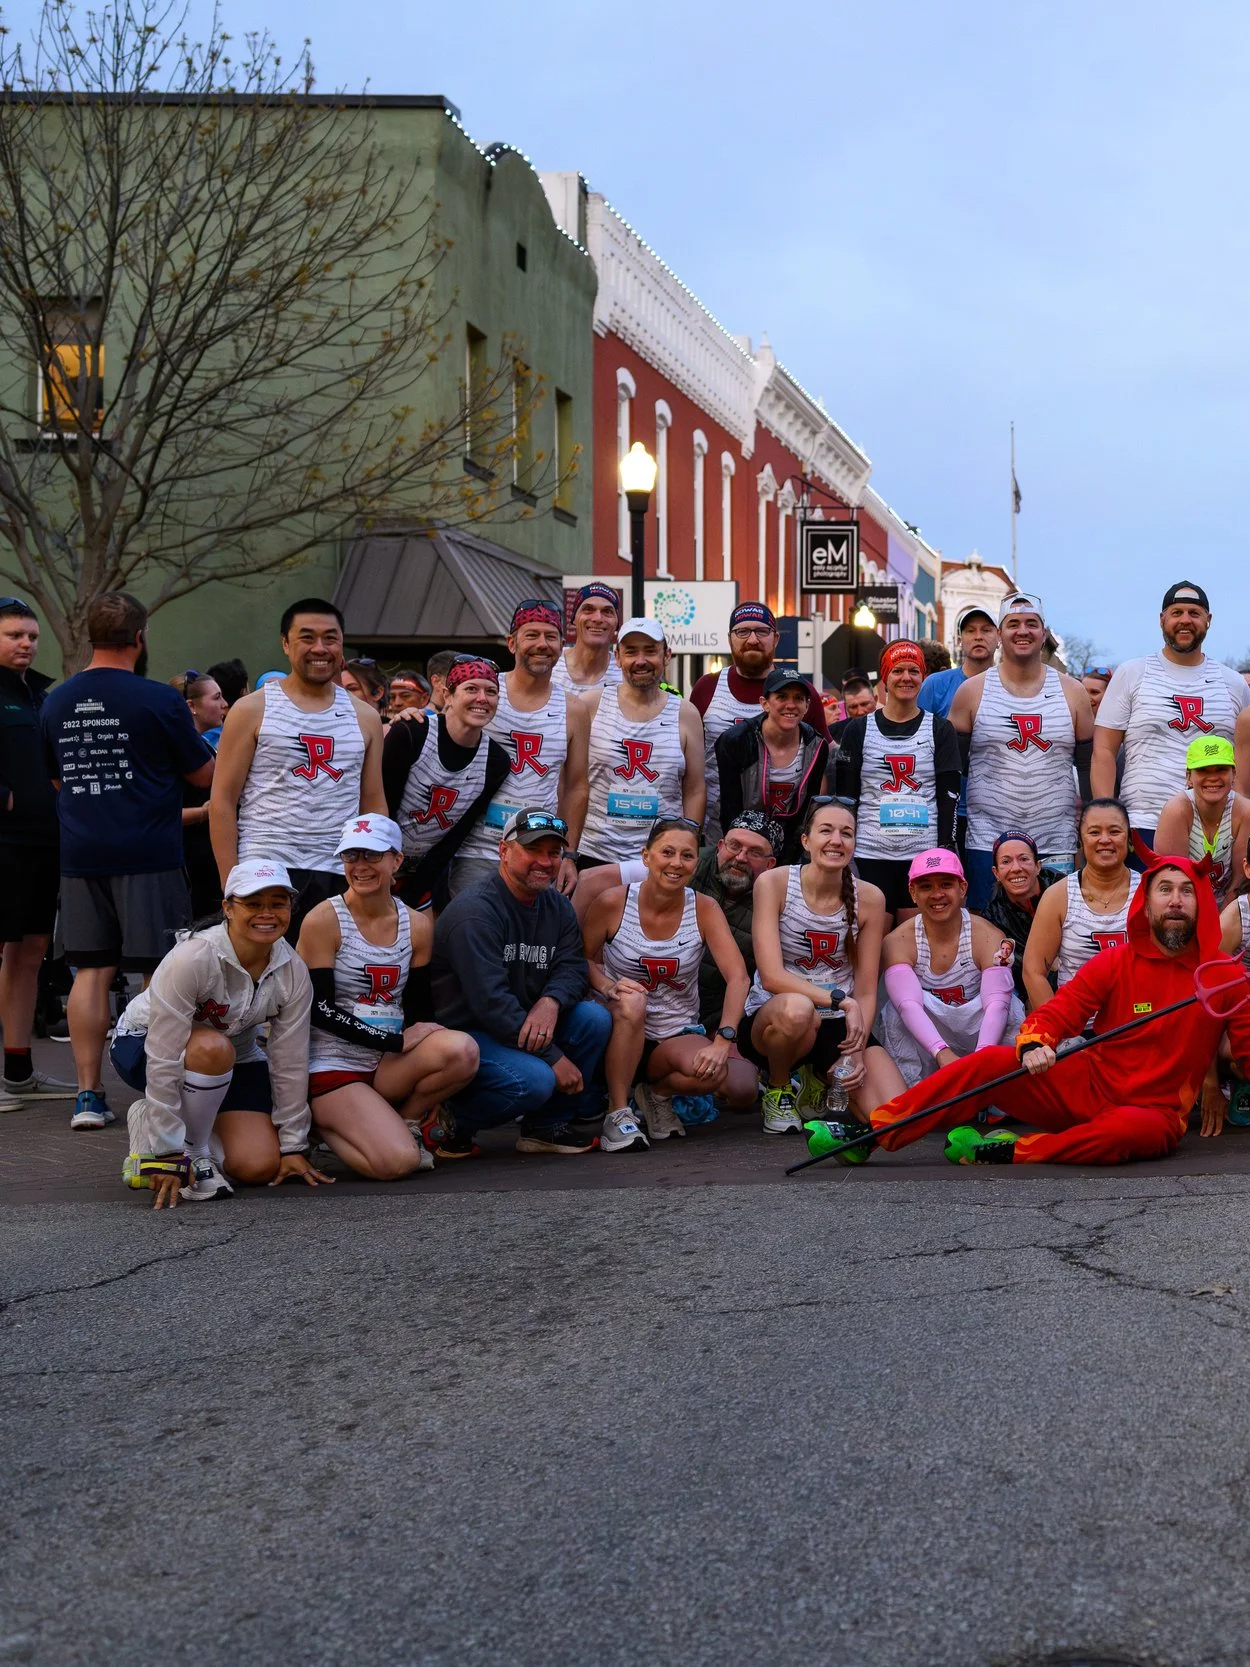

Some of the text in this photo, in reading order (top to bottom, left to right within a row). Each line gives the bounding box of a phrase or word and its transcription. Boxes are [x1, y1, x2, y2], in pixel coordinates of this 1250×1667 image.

[812, 539, 847, 564] eM
[63, 718, 120, 729] 2022 SPONSORS
[614, 799, 653, 810] 1546
[888, 808, 921, 818] 1041
